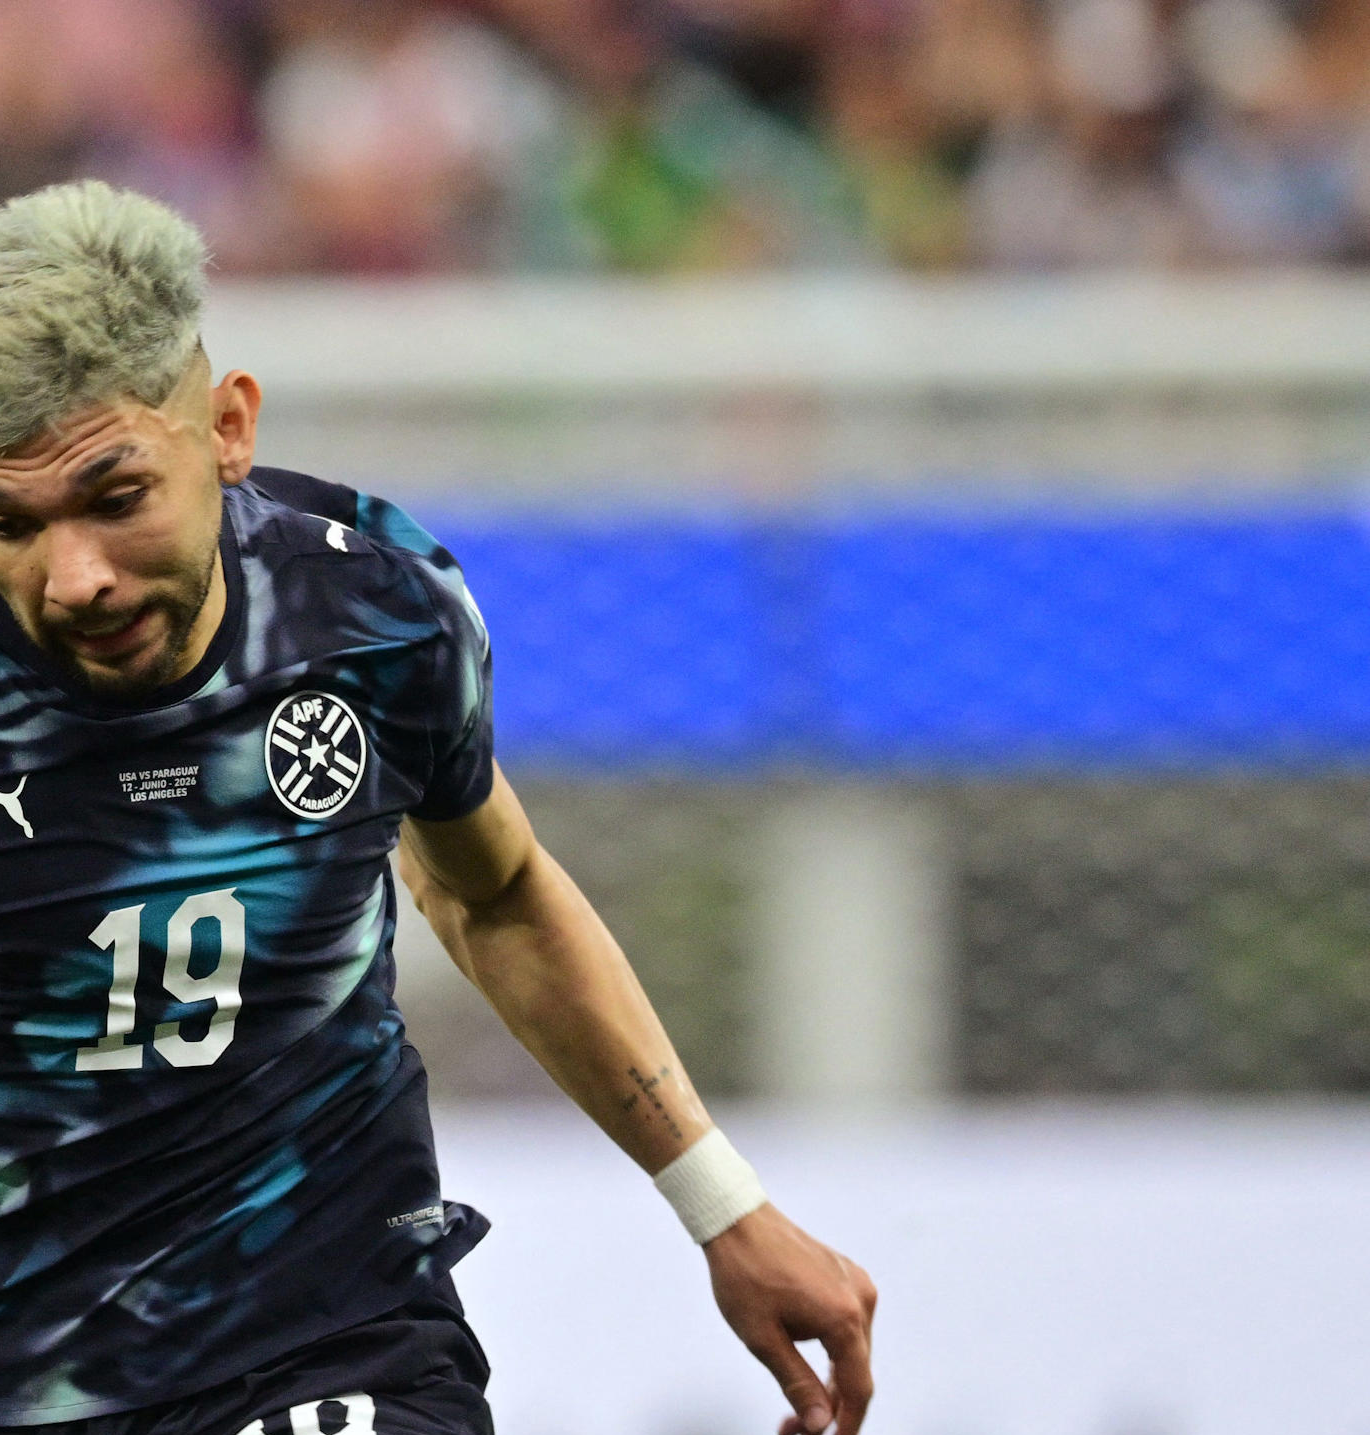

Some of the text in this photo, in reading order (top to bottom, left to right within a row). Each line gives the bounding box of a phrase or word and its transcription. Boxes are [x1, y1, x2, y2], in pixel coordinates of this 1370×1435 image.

[292, 698, 323, 724] APF
[119, 765, 199, 782] USA VS PARAGUAY
[122, 782, 133, 793] 12
[139, 779, 167, 791] JUNIO
[174, 776, 197, 787] 2026
[130, 787, 188, 802] LOS ANGELES
[299, 787, 344, 811] PARAGUAY
[74, 886, 246, 1072] 19
[386, 1205, 444, 1229] ULTRAWEA
